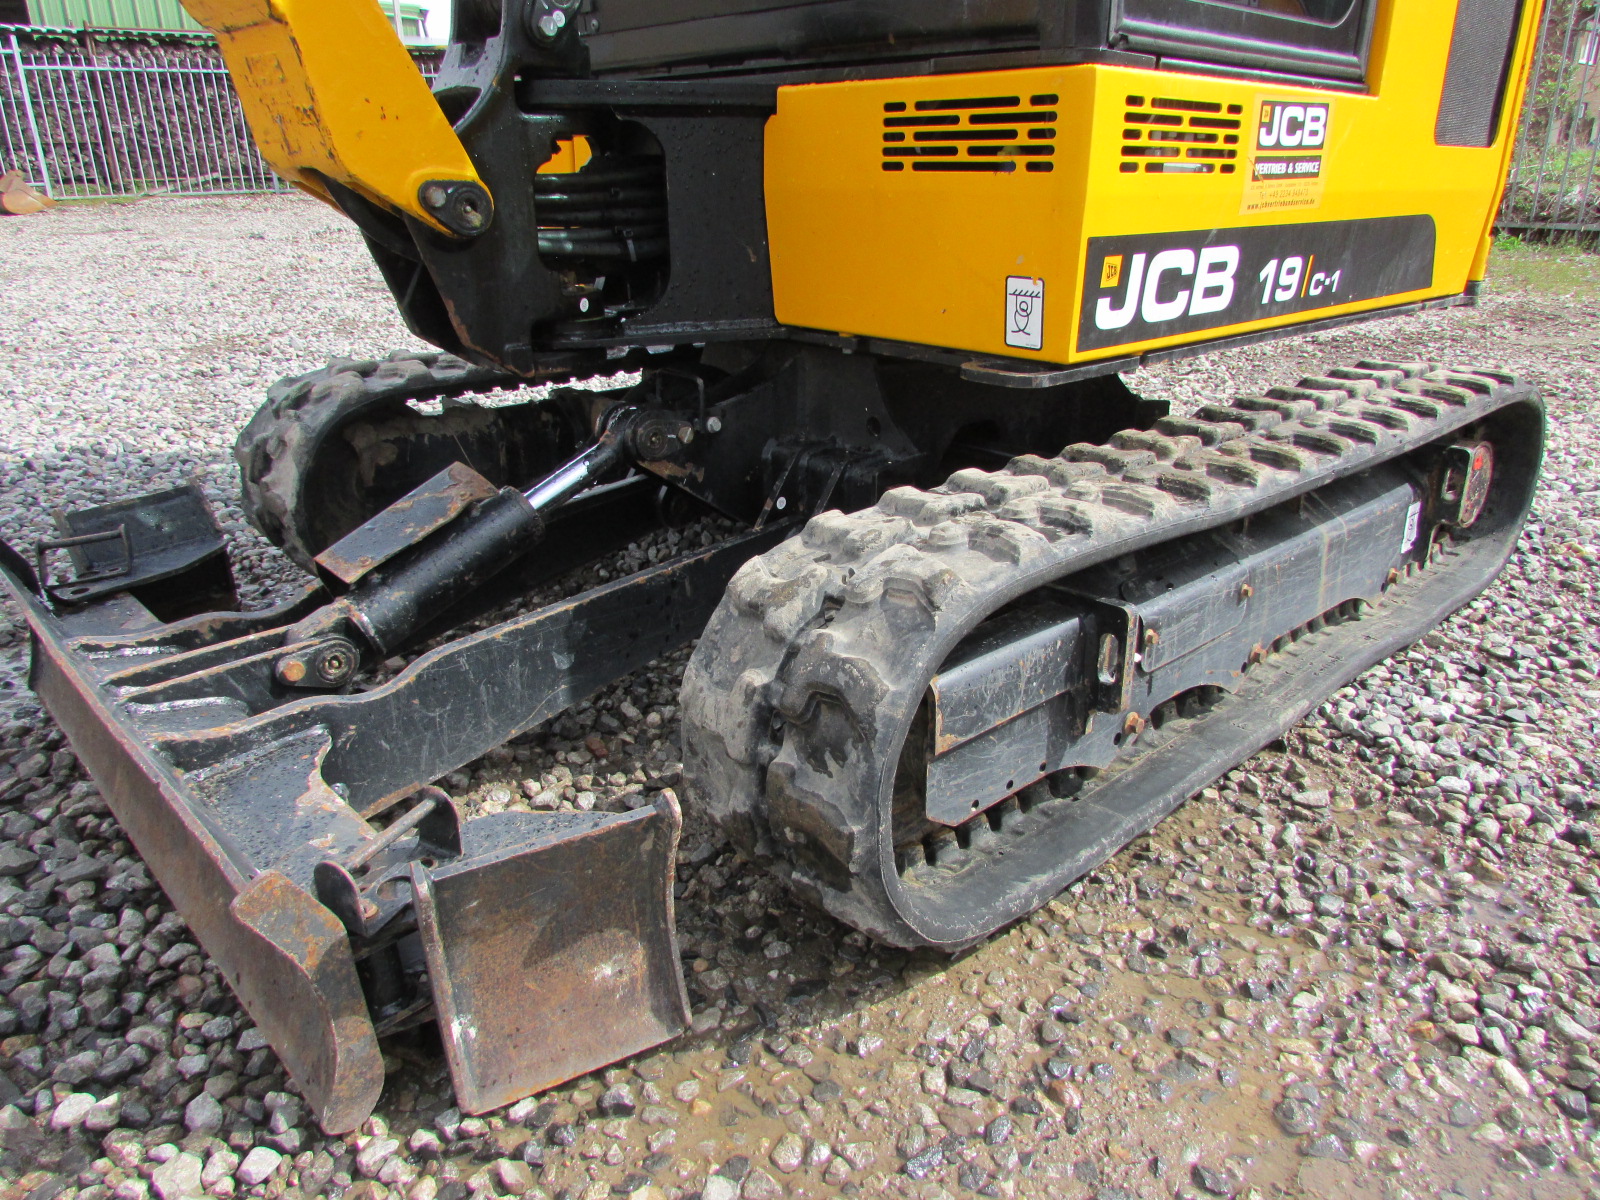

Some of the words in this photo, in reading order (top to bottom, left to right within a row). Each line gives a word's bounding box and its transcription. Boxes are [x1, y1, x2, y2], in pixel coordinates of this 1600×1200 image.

[1259, 105, 1326, 147] JCB
[1255, 163, 1287, 176] VERTRIEB
[1287, 163, 1294, 174] &
[1294, 161, 1320, 173] SERVICE
[1106, 264, 1118, 280] JCB
[1095, 245, 1240, 330] JCB
